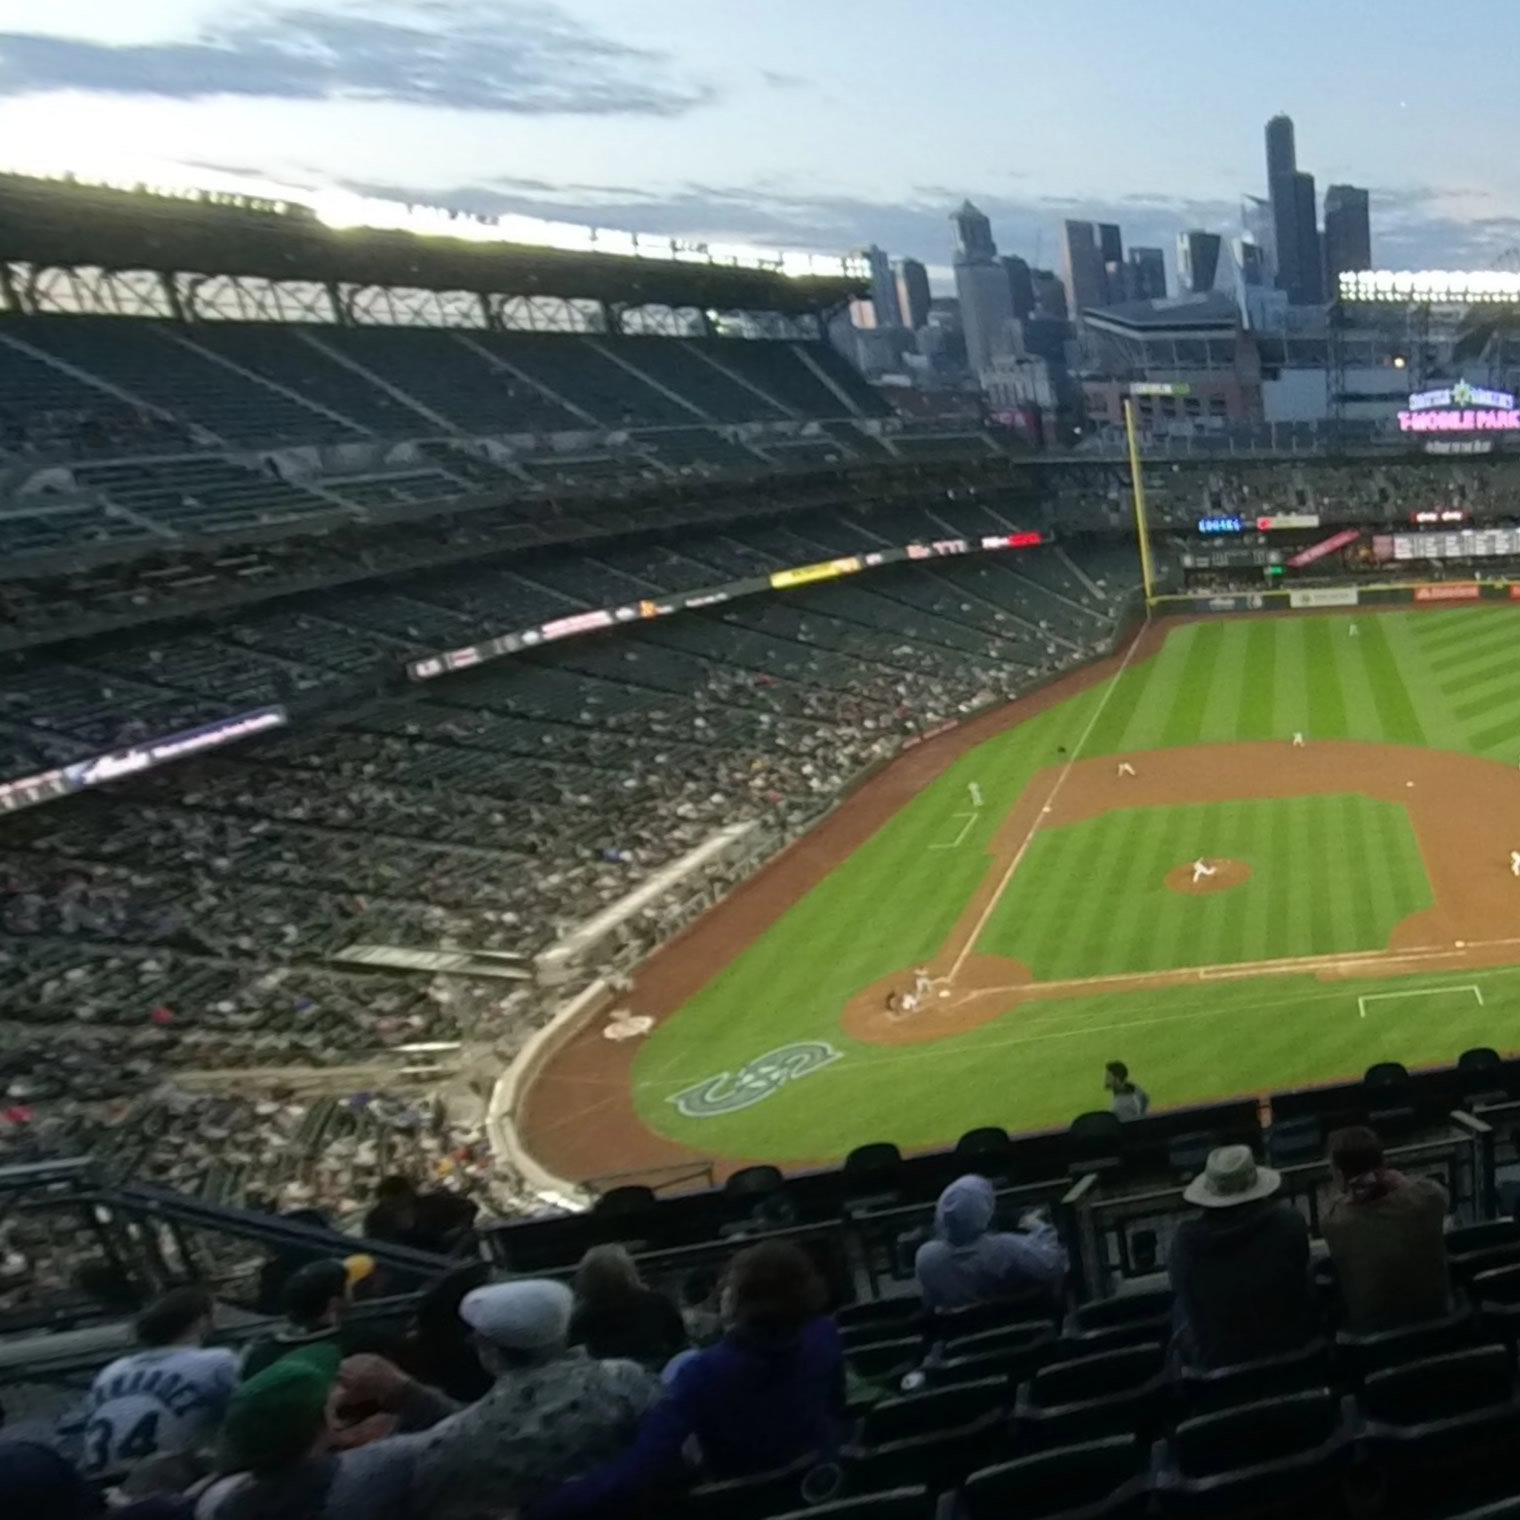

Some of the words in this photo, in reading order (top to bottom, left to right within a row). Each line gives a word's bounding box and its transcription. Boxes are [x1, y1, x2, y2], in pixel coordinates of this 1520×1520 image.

[1398, 411, 1475, 430] T-MOBILE
[1477, 410, 1520, 429] PARK
[86, 1410, 161, 1473] 34
